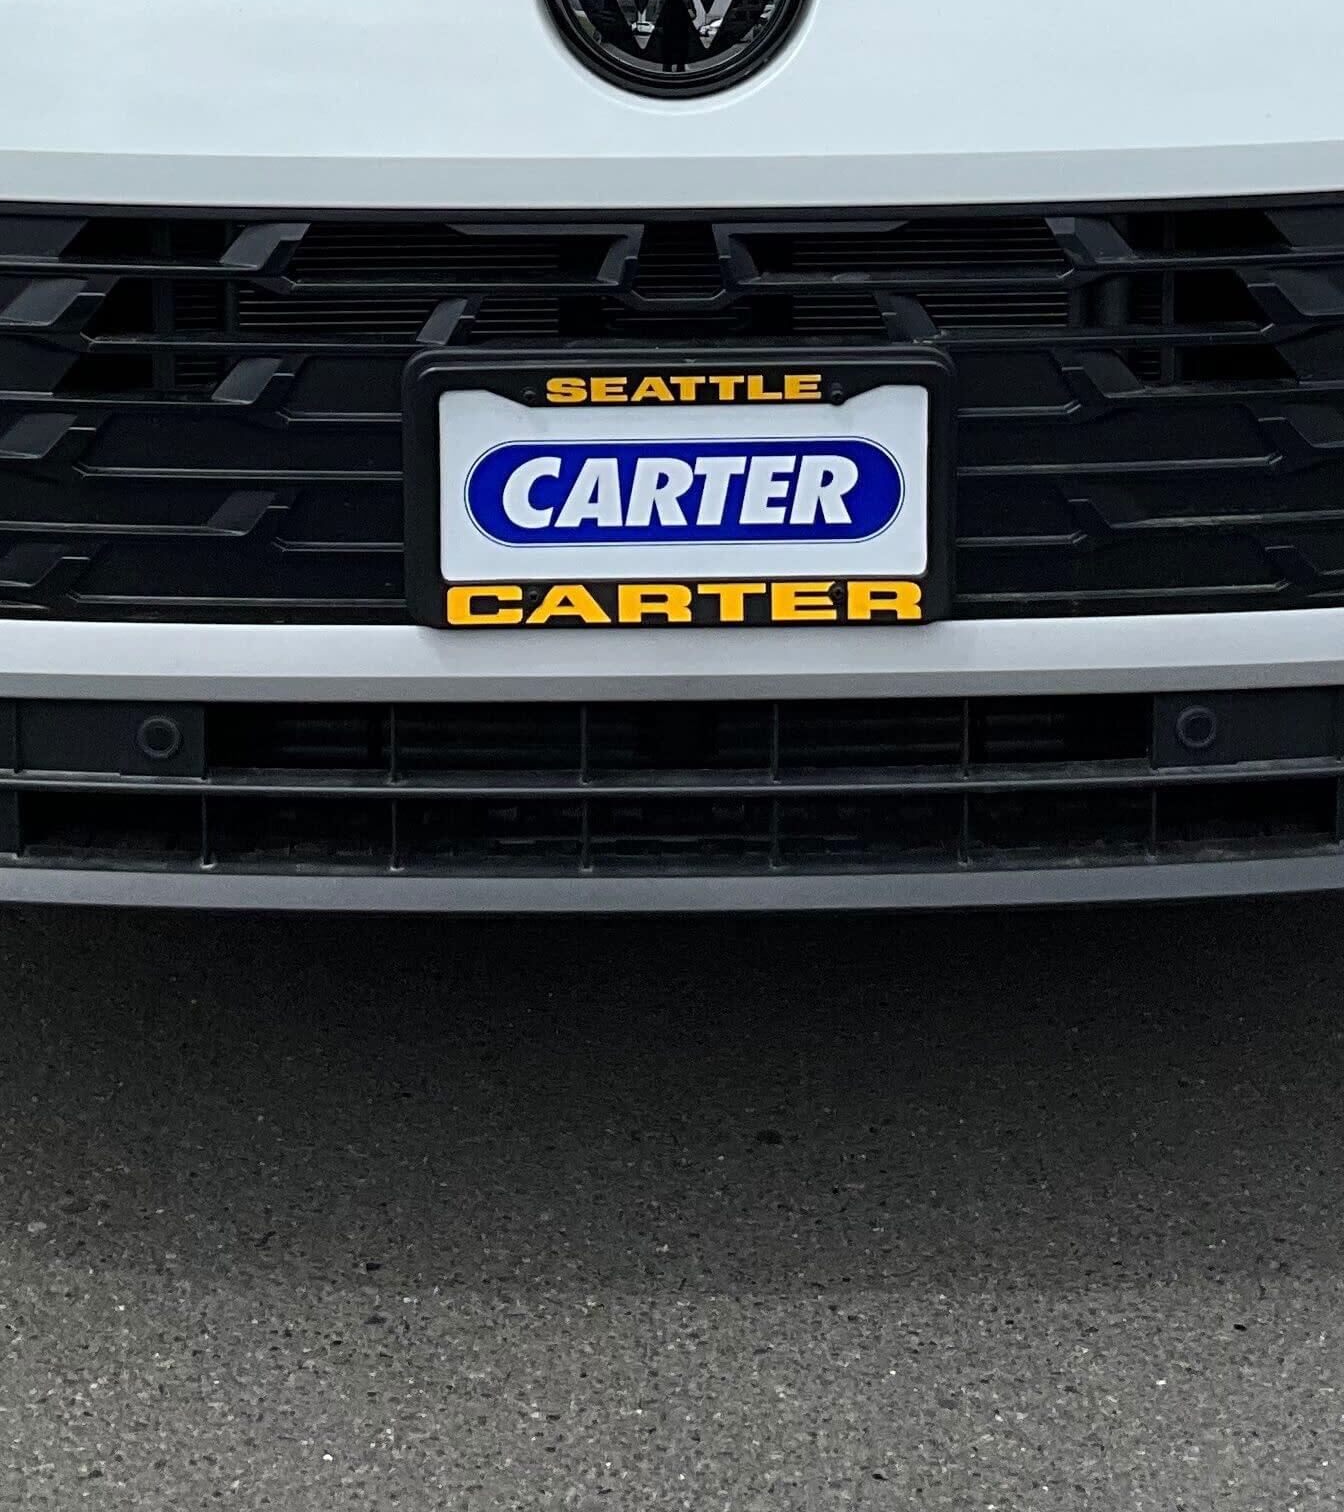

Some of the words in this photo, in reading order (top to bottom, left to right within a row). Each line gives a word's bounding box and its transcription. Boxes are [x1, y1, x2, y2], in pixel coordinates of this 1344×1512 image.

[546, 374, 822, 403] SEATTLE
[501, 454, 859, 529] CARTER
[446, 580, 923, 625] CARTER
